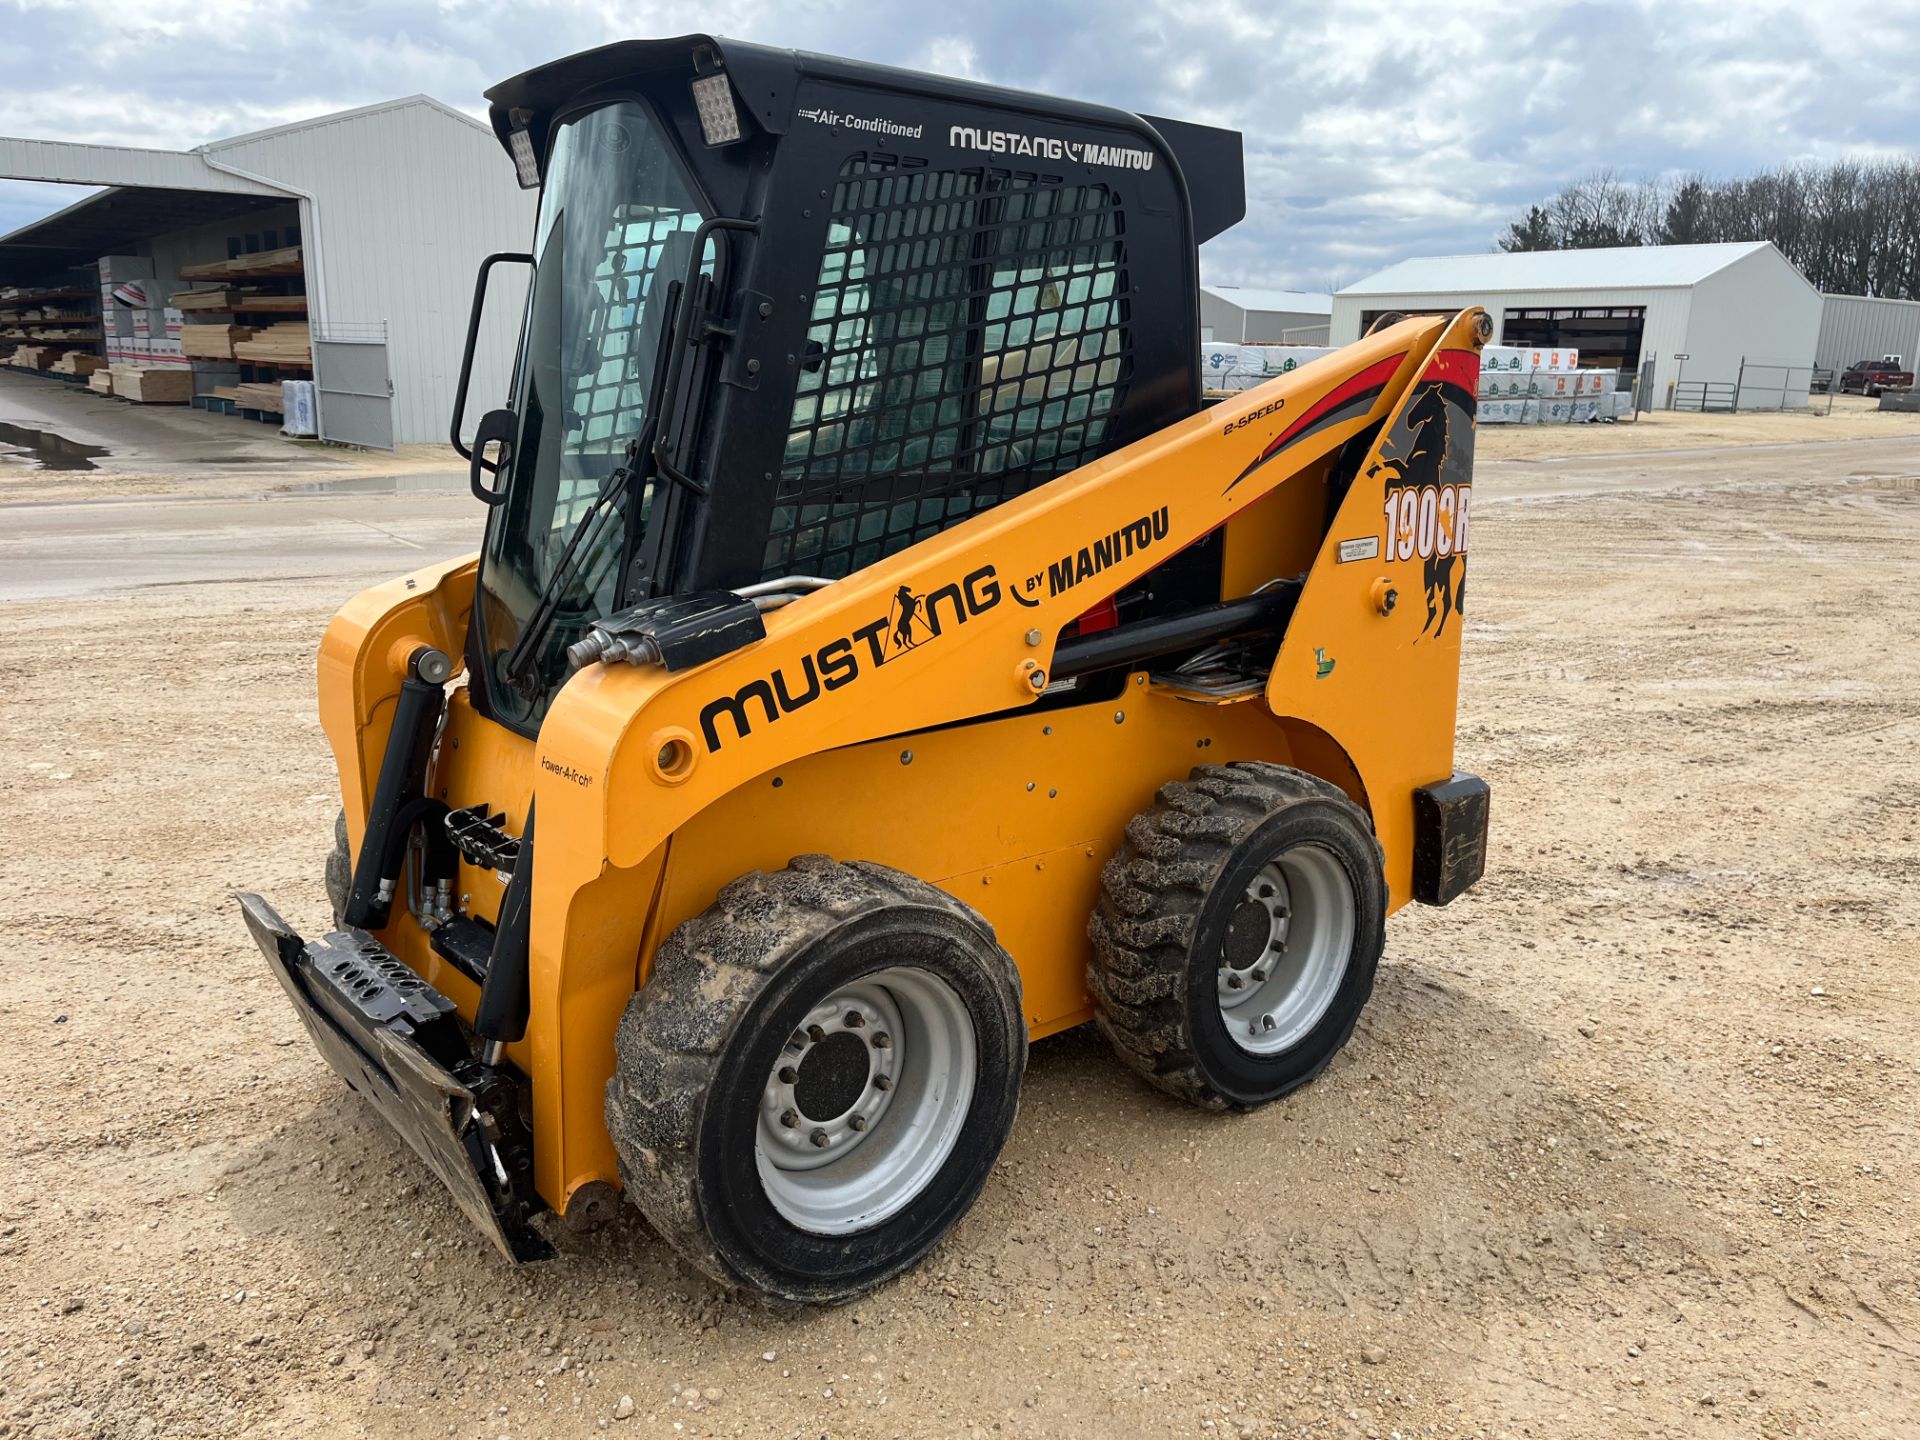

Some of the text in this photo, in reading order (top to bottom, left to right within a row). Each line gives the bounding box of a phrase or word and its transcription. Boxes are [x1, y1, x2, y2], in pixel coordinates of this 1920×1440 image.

[819, 110, 922, 138] Air-Conditioned
[950, 126, 1154, 171] MUSTANG BY MANITOU
[1223, 398, 1285, 436] 2-SPEED
[700, 505, 1169, 753] MUSTANG BY MANITOU
